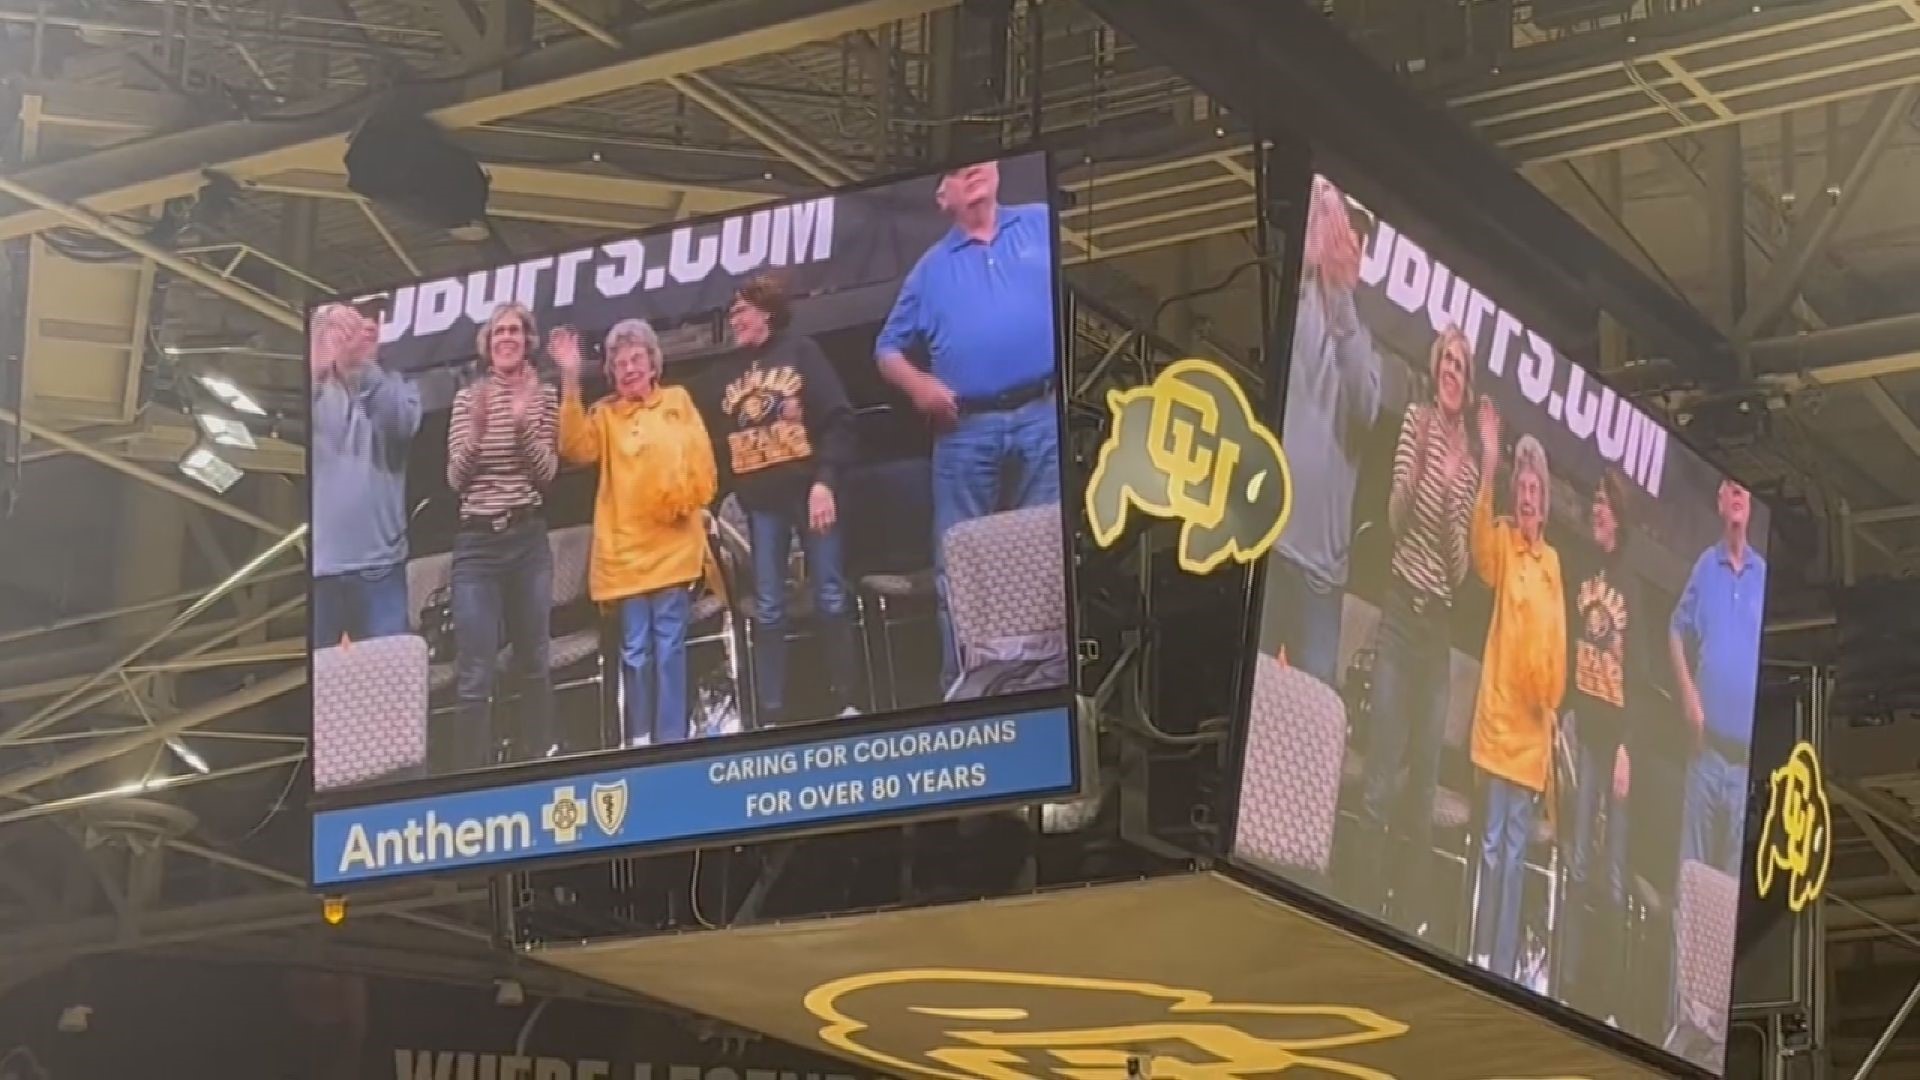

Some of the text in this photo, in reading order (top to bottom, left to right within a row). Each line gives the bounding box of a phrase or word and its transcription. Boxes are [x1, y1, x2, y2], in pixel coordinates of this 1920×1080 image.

[709, 719, 1016, 784] CARING FOR COLORADANS
[746, 762, 987, 817] FOR OVER 80 YEARS
[339, 810, 531, 873] Anthem
